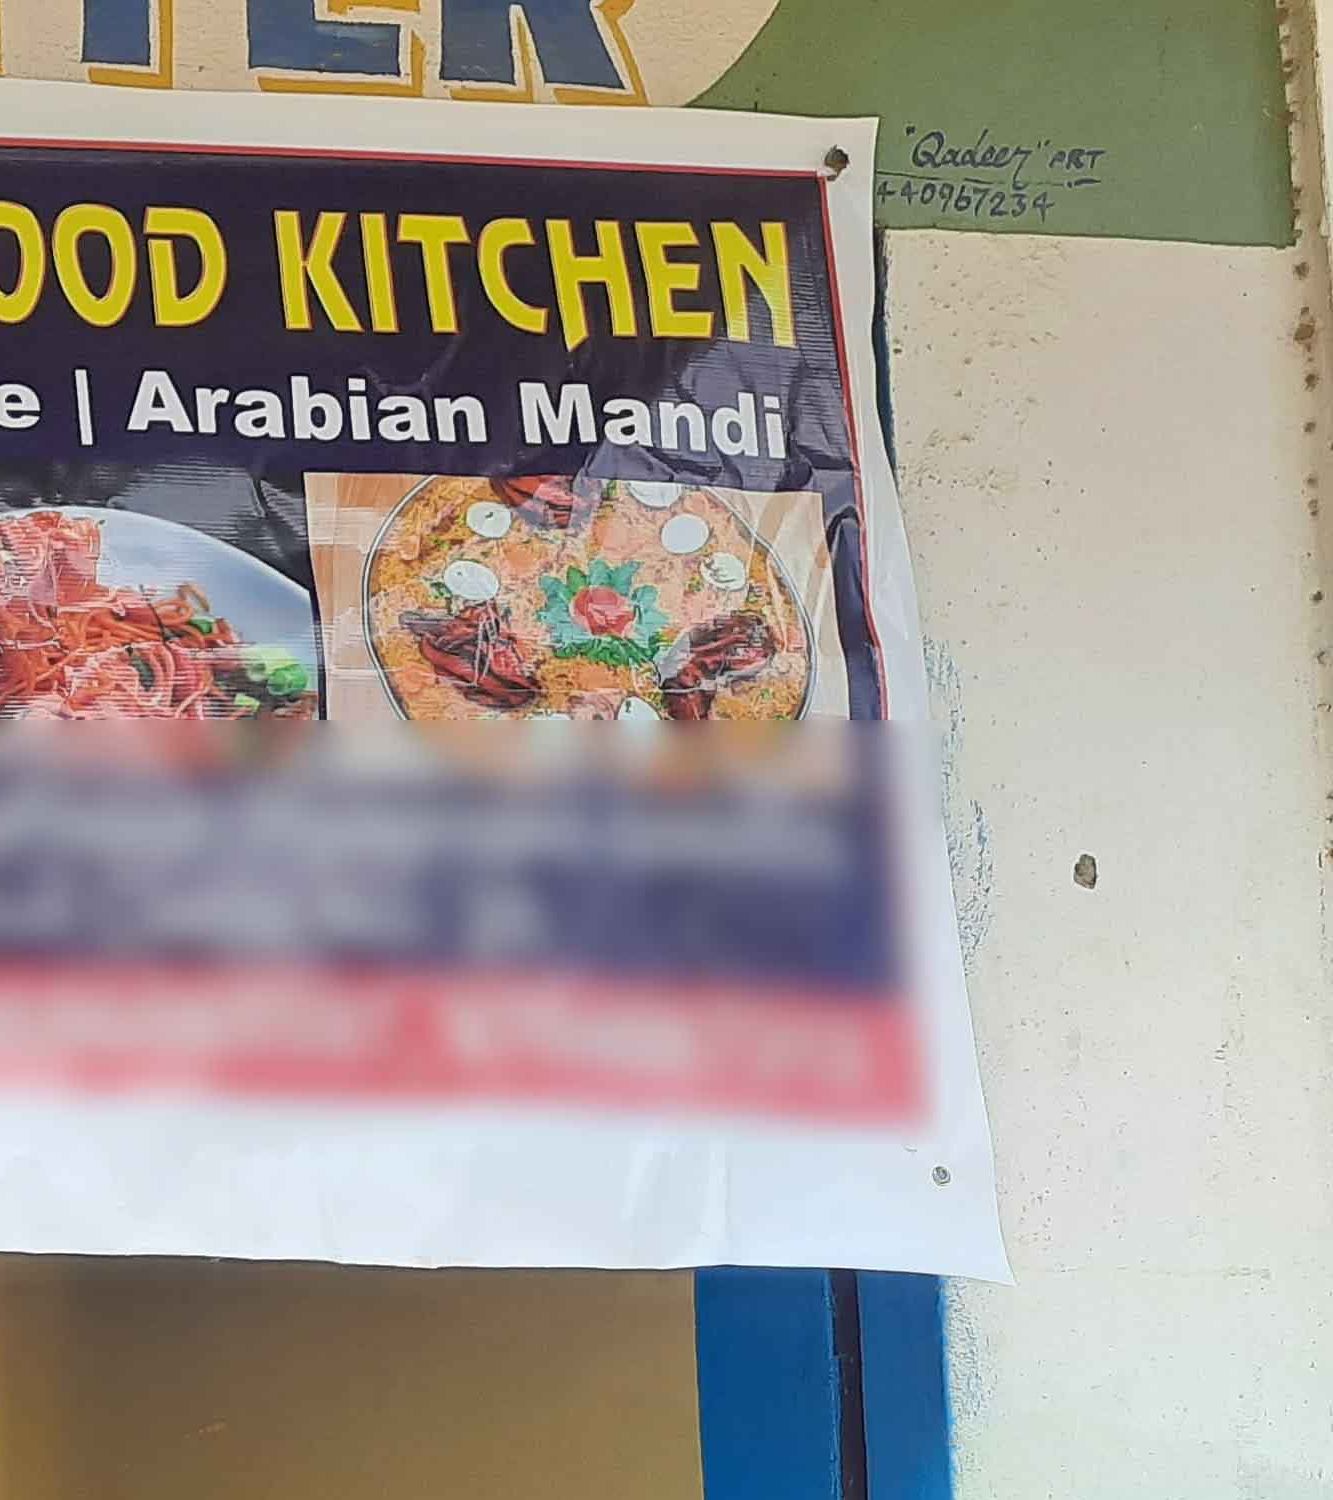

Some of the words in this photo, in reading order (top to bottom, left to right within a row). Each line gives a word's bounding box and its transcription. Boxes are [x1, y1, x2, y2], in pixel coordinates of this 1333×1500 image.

[274, 209, 796, 352] KITCHEN
[126, 370, 489, 443] Arabian
[518, 381, 788, 460] Mandi
